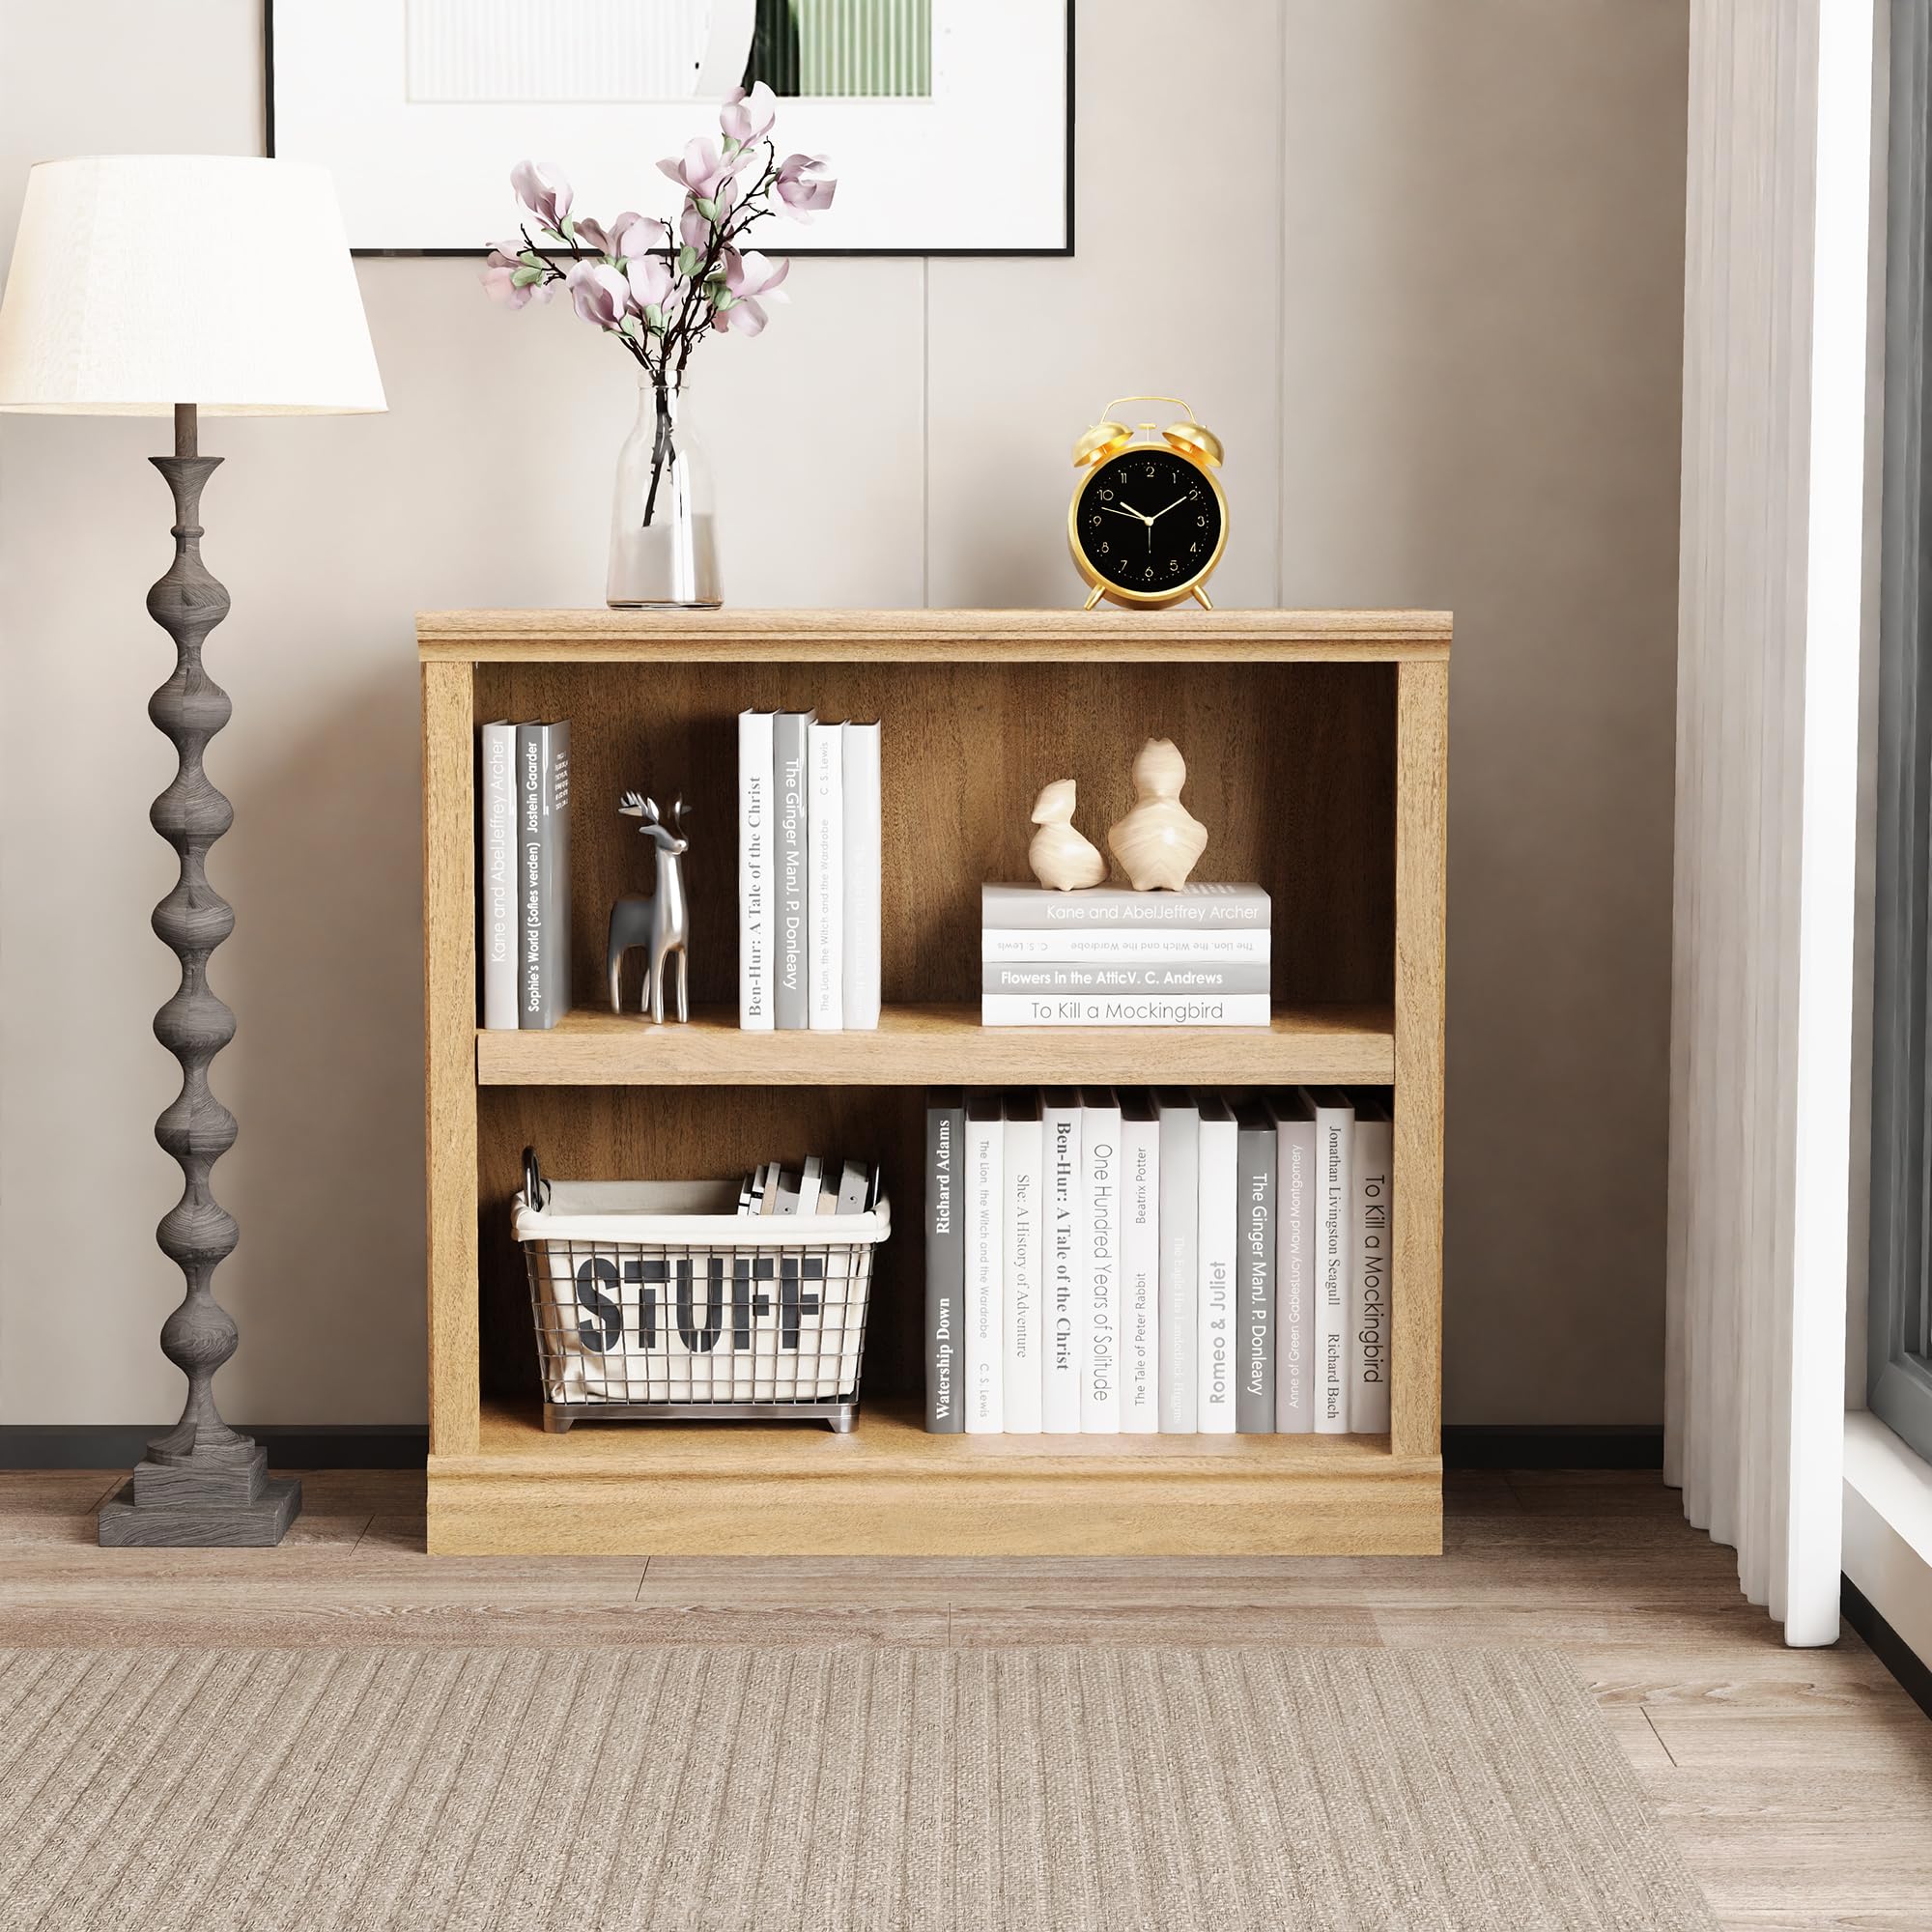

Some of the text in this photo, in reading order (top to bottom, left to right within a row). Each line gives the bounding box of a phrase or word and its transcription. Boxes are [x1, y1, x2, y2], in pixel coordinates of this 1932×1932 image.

[1099, 489, 1114, 500] 10
[1093, 515, 1102, 526] 9
[1196, 515, 1206, 526] 3
[1101, 542, 1110, 553] 8
[1121, 559, 1128, 571] 7
[1145, 566, 1153, 578] 6
[1170, 559, 1179, 571] 5
[489, 739, 504, 790] Archer
[526, 742, 538, 790] Gaarder
[819, 742, 830, 770] Lewis
[786, 758, 800, 787] The
[526, 794, 538, 834] Jostein
[782, 792, 800, 845] Ginger
[819, 819, 830, 870] Wardrobe
[526, 842, 541, 888] verden)
[819, 873, 830, 890] the
[491, 886, 505, 915] and
[749, 779, 761, 1015] Ben-Hur: A Tale of the Christ
[819, 893, 830, 914] and
[1046, 904, 1085, 920] Kane
[1090, 904, 1119, 920] and
[1209, 904, 1259, 920] Archer
[492, 923, 506, 962] Kane
[527, 930, 540, 962] World
[782, 916, 800, 990] Donleavy
[819, 948, 830, 965] the
[997, 942, 1024, 952] Lewis
[1071, 941, 1120, 952] Wardrobe
[1122, 941, 1138, 952] the
[1141, 941, 1160, 952] and
[1163, 941, 1190, 952] Witch
[1192, 941, 1208, 952] the
[1236, 941, 1254, 952] The
[527, 965, 542, 1012] Sophie's
[1002, 971, 1050, 984] Flowers
[1070, 971, 1092, 984] the
[1164, 971, 1222, 984] Andrews
[819, 994, 830, 1012] The
[1032, 1003, 1222, 1023] To Kill a Mockingbird
[980, 1140, 990, 1158] The
[935, 1120, 952, 1234] Richard Adams
[1135, 1147, 1147, 1224] Beatrix Potter
[1252, 1173, 1267, 1201] The
[1290, 1144, 1304, 1217] Montgomery
[980, 1189, 990, 1207] the
[980, 1209, 990, 1239] Witch
[1325, 1126, 1341, 1305] Jonathan Livingston Seagull
[1057, 1122, 1071, 1369] Ben-Hur: A Tale of the Christ
[1248, 1206, 1267, 1257] Ginger
[1290, 1220, 1300, 1254] Maud
[980, 1242, 990, 1264] and
[1013, 1175, 1030, 1358] She: A History of Adventure
[980, 1266, 990, 1283] the
[1094, 1145, 1113, 1401] One Hundred Years of Solitude
[1359, 1175, 1385, 1383] To Kill a Mockingbird
[578, 1258, 823, 1352] STUFF
[980, 1286, 990, 1339] Wardrobe
[1135, 1274, 1145, 1406] The Tale of Peter Rabbit
[1209, 1262, 1226, 1405] Romeo & Juliet
[1290, 1324, 1300, 1361] Green
[935, 1298, 953, 1420] Watership Down
[1247, 1325, 1267, 1396] Donleavy
[1290, 1363, 1300, 1376] of
[1327, 1334, 1340, 1418] Richard Bach
[980, 1389, 990, 1418] Lewis
[1290, 1378, 1300, 1407] Anne
